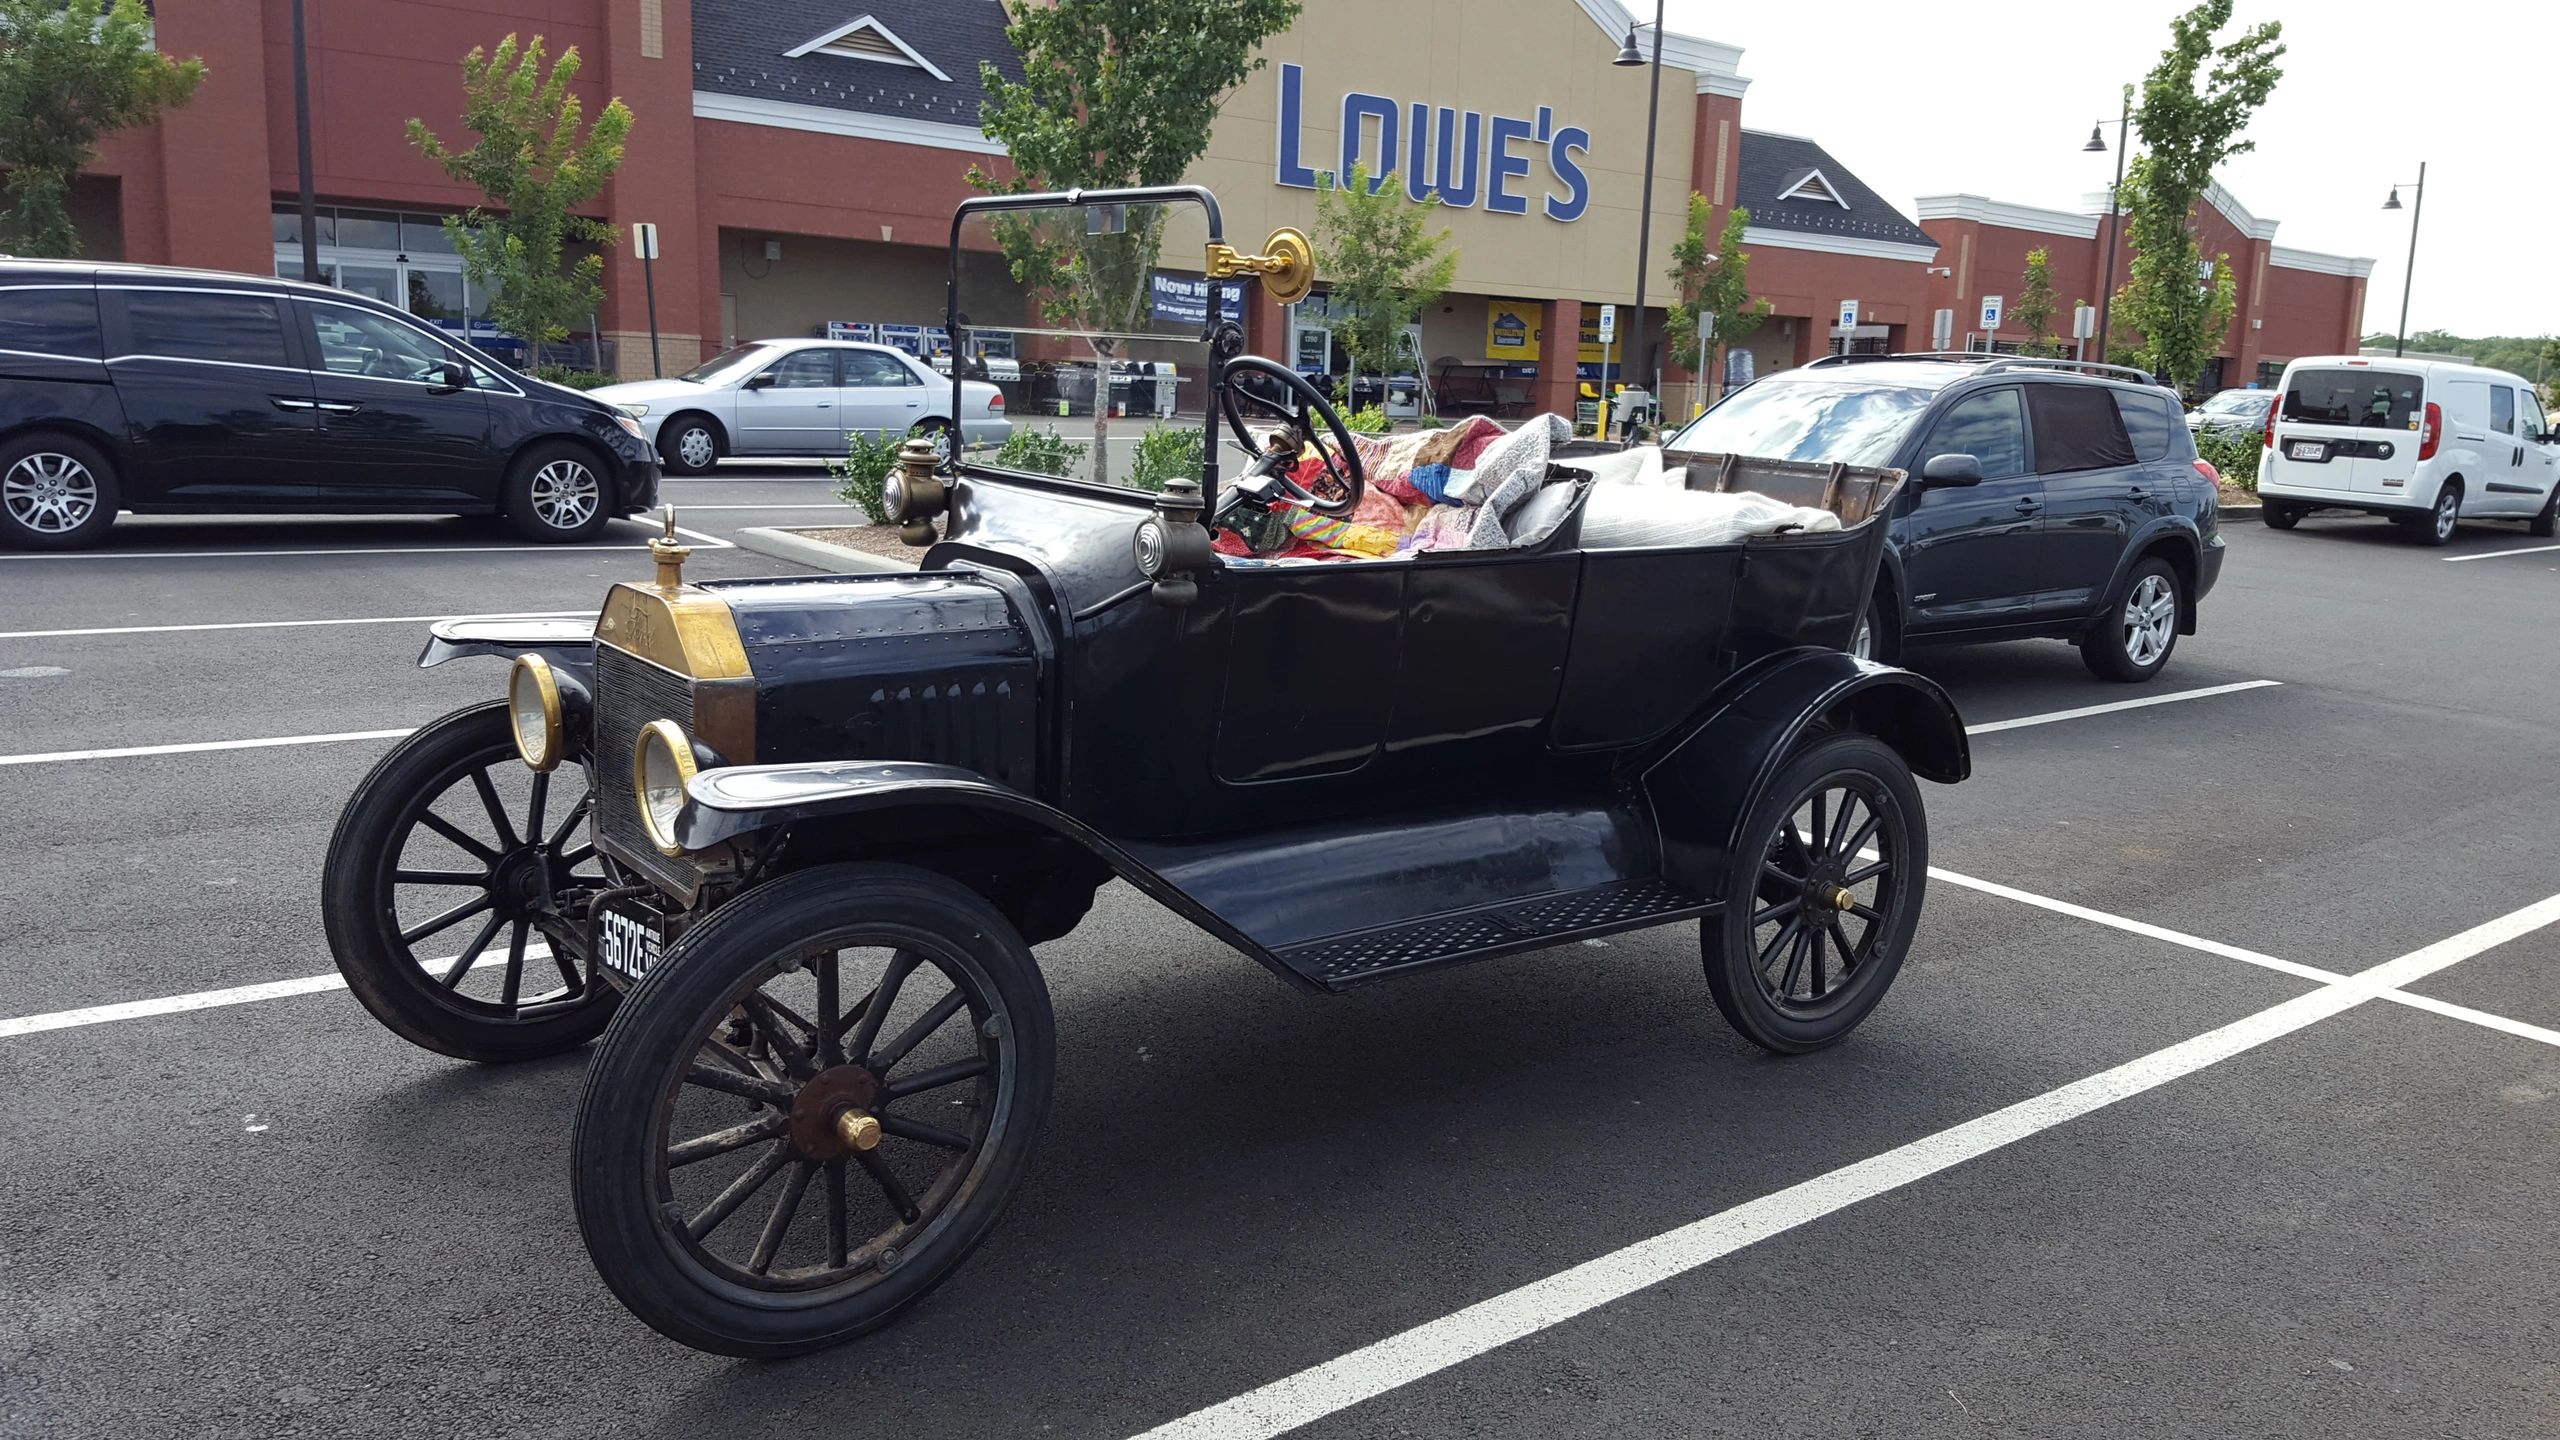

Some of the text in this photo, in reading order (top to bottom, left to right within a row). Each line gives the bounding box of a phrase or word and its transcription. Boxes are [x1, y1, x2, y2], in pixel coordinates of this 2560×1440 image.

[1275, 62, 1591, 222] LOWE'S
[1155, 276, 1192, 296] Now
[1194, 282, 1241, 302] Hing
[605, 909, 645, 980] 5672E
